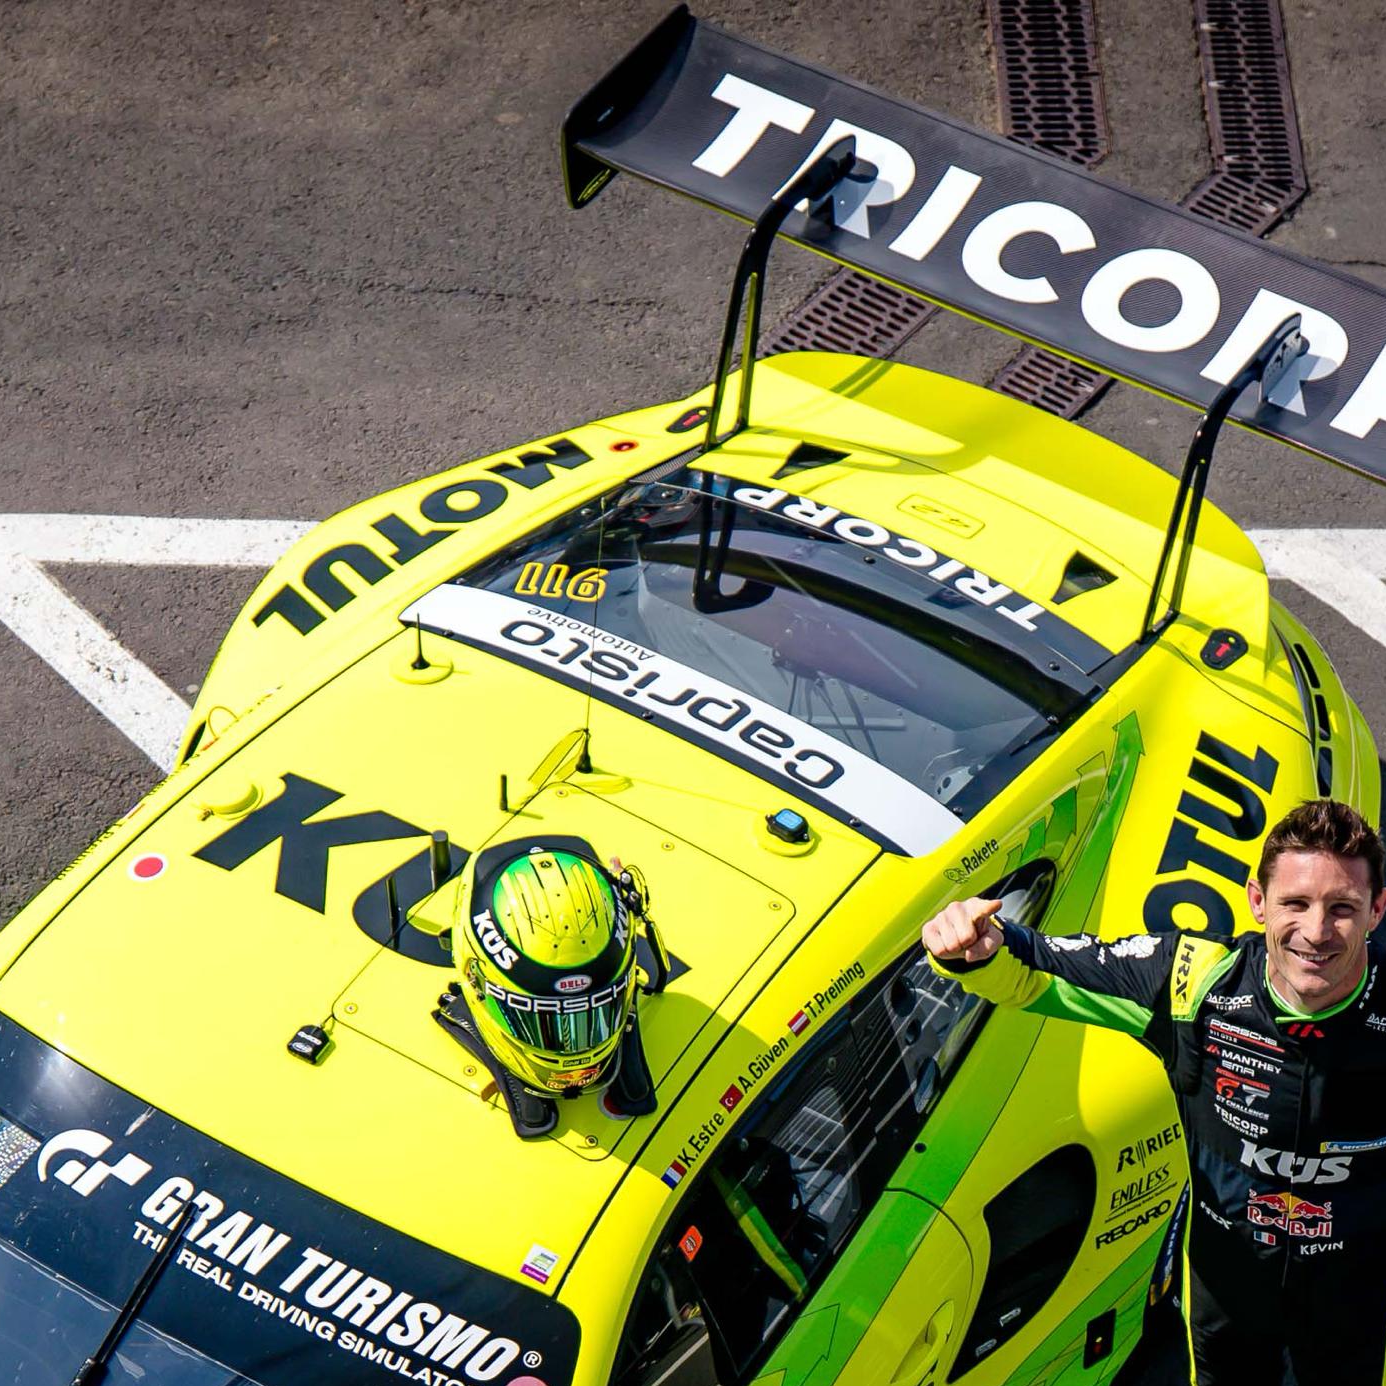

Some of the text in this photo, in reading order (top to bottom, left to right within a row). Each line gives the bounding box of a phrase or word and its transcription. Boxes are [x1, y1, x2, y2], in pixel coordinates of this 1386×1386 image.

[250, 435, 594, 636] MOTUL
[733, 484, 1047, 633] TRICORP
[525, 606, 657, 663] Automotive
[498, 616, 844, 792] Capristo
[960, 837, 1001, 877] Rakete
[1143, 729, 1280, 937] OTUL
[473, 908, 519, 971] KÜS
[484, 968, 631, 1015] PORSCH
[558, 978, 589, 991] BELL
[804, 960, 867, 1022] T.Preining
[1209, 1018, 1278, 1047] PORSCHE
[736, 1035, 791, 1095] A.Güven
[1221, 1049, 1282, 1075] MANTHEY
[678, 1111, 726, 1170] K.Estre
[1214, 1103, 1269, 1136] TRICORP
[1110, 1162, 1171, 1211] ENDLESS
[1240, 1138, 1355, 1185] KÜS
[1095, 1199, 1172, 1250] RECARO
[1247, 1205, 1333, 1238] Red Bull
[1300, 1240, 1345, 1256] KEVIN
[140, 1174, 523, 1382] GRAN TURISMO
[177, 1246, 234, 1292] REAL
[238, 1282, 336, 1343] DRIVING
